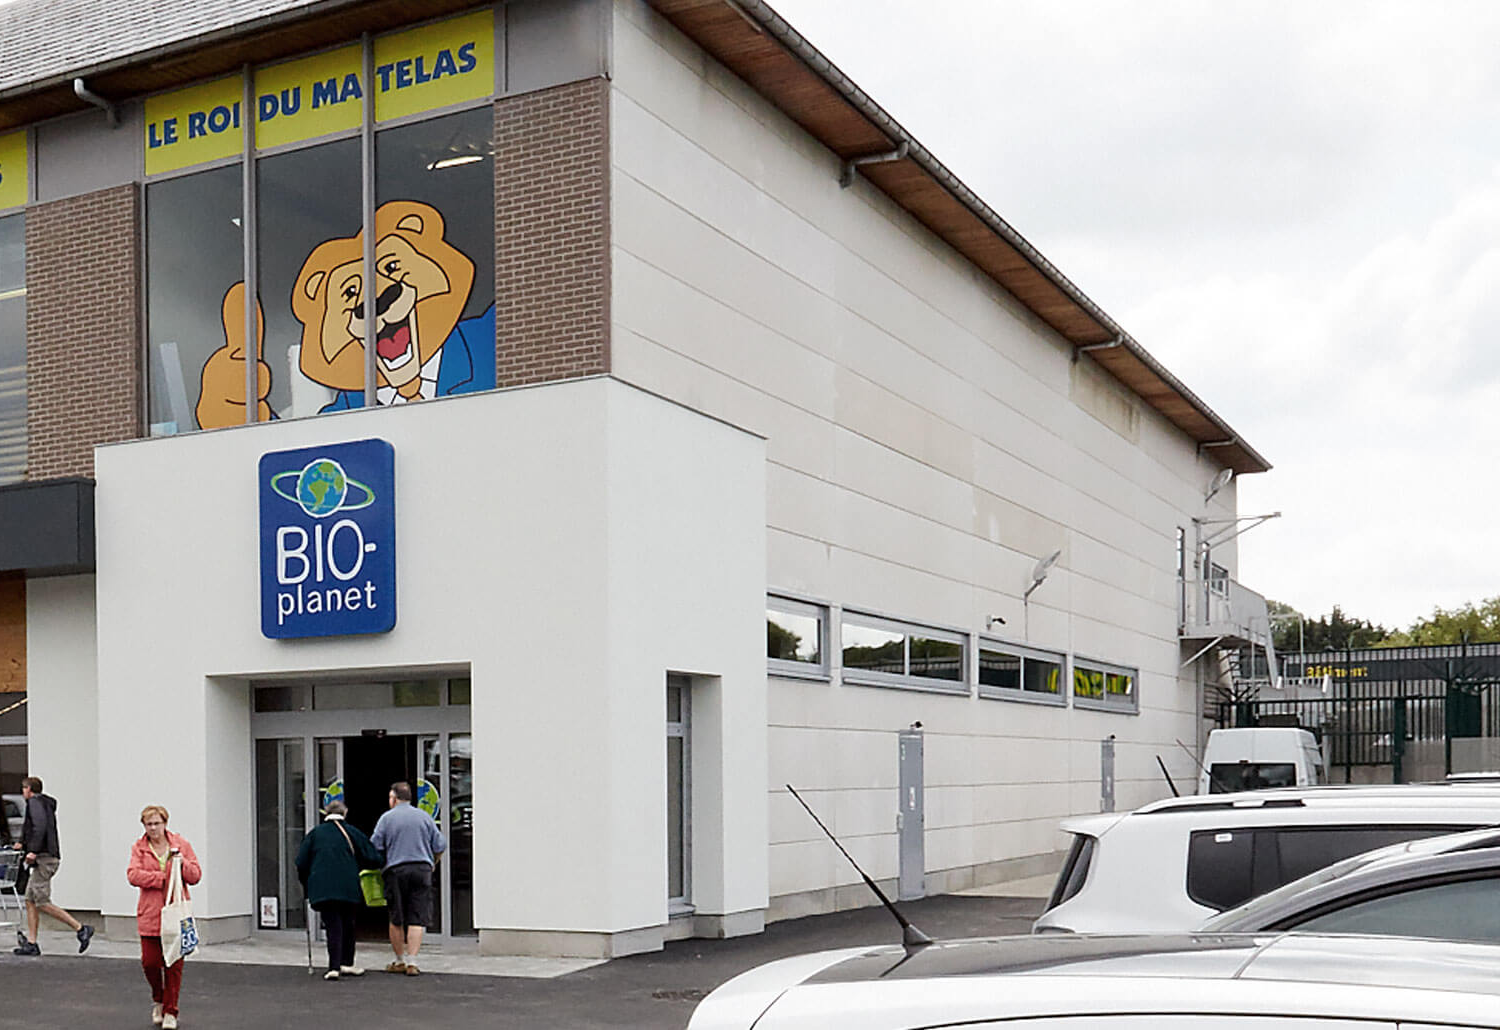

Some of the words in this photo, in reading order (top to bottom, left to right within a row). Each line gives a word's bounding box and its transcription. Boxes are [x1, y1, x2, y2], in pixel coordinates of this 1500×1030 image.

[148, 119, 178, 149] LE
[188, 102, 241, 139] ROI
[259, 87, 301, 122] DU
[312, 42, 478, 109] MATELAS
[276, 518, 377, 585] BIO-
[277, 580, 377, 625] planet
